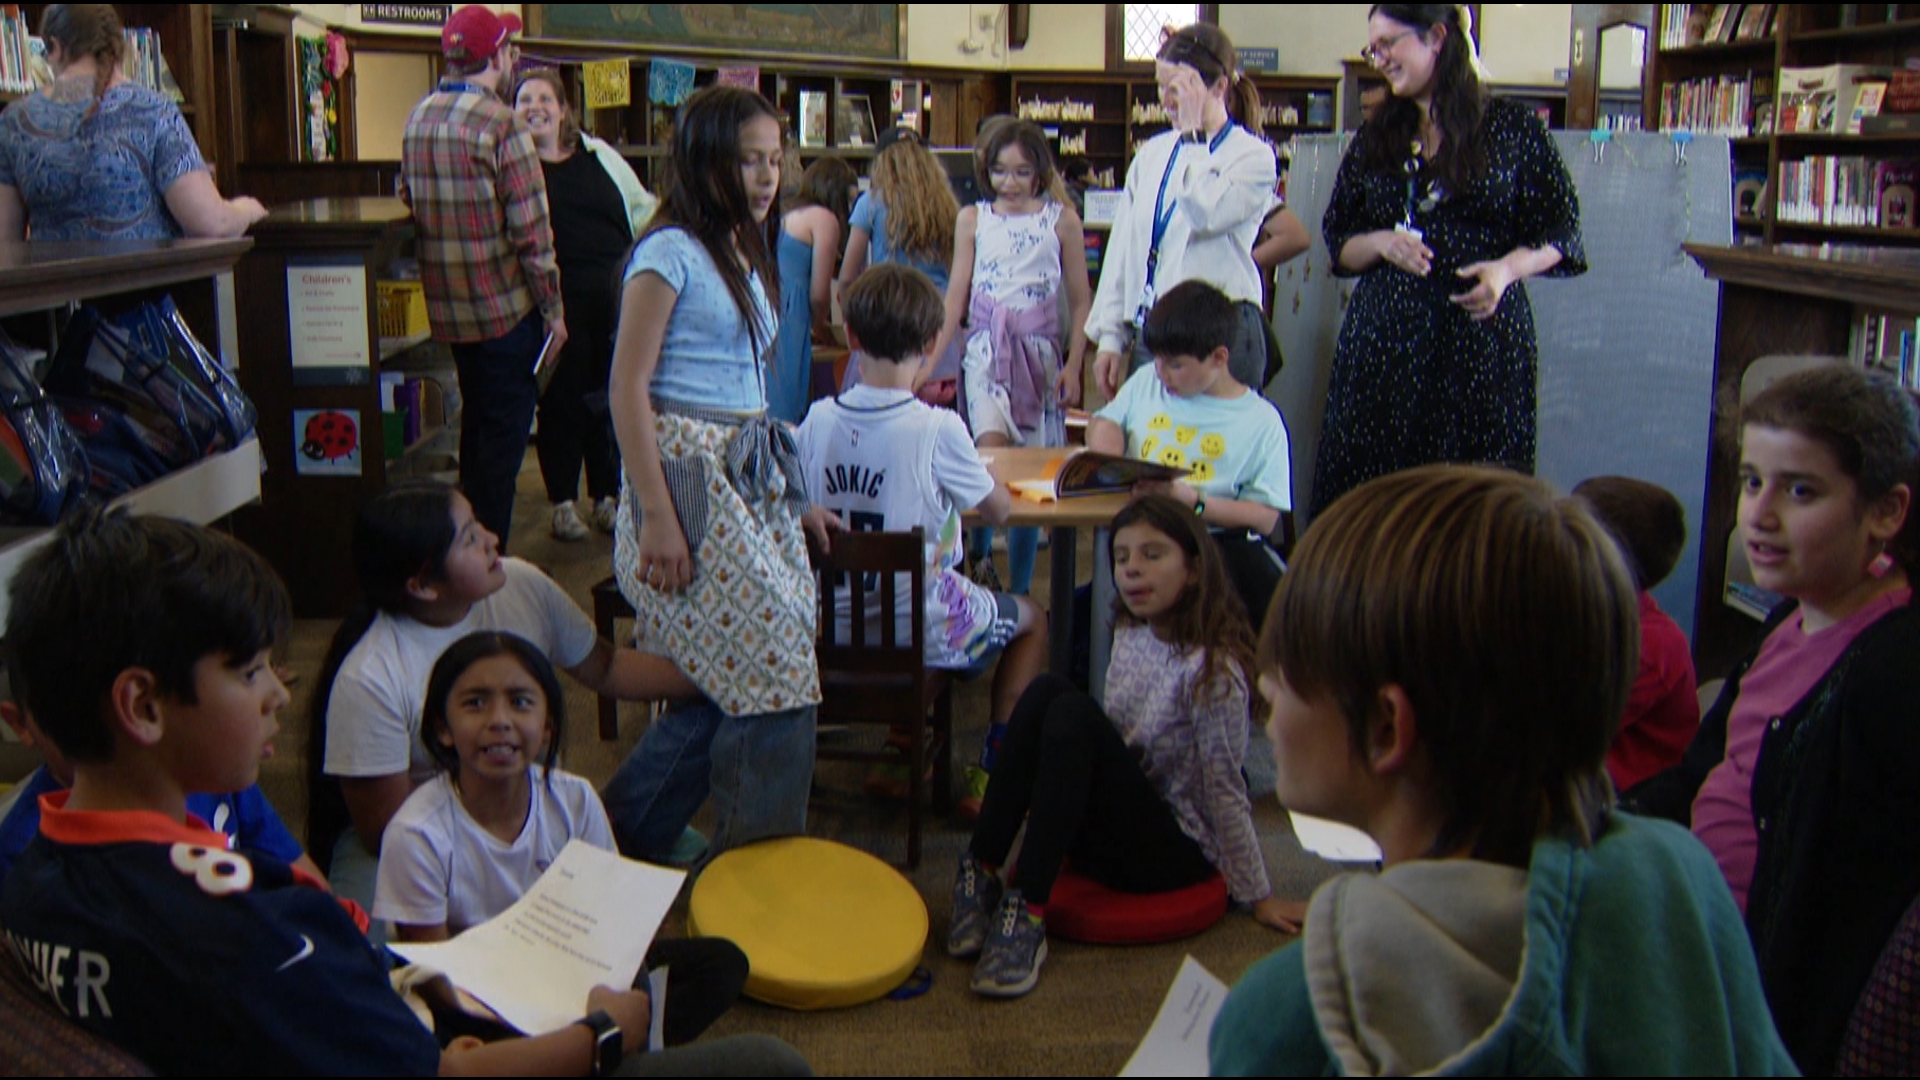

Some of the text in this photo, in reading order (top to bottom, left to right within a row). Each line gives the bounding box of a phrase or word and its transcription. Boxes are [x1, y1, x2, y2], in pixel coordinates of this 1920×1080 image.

[378, 5, 441, 20] RESTROOMS
[301, 274, 351, 285] Children's
[825, 464, 885, 498] JOKIĆ
[170, 842, 254, 896] 8
